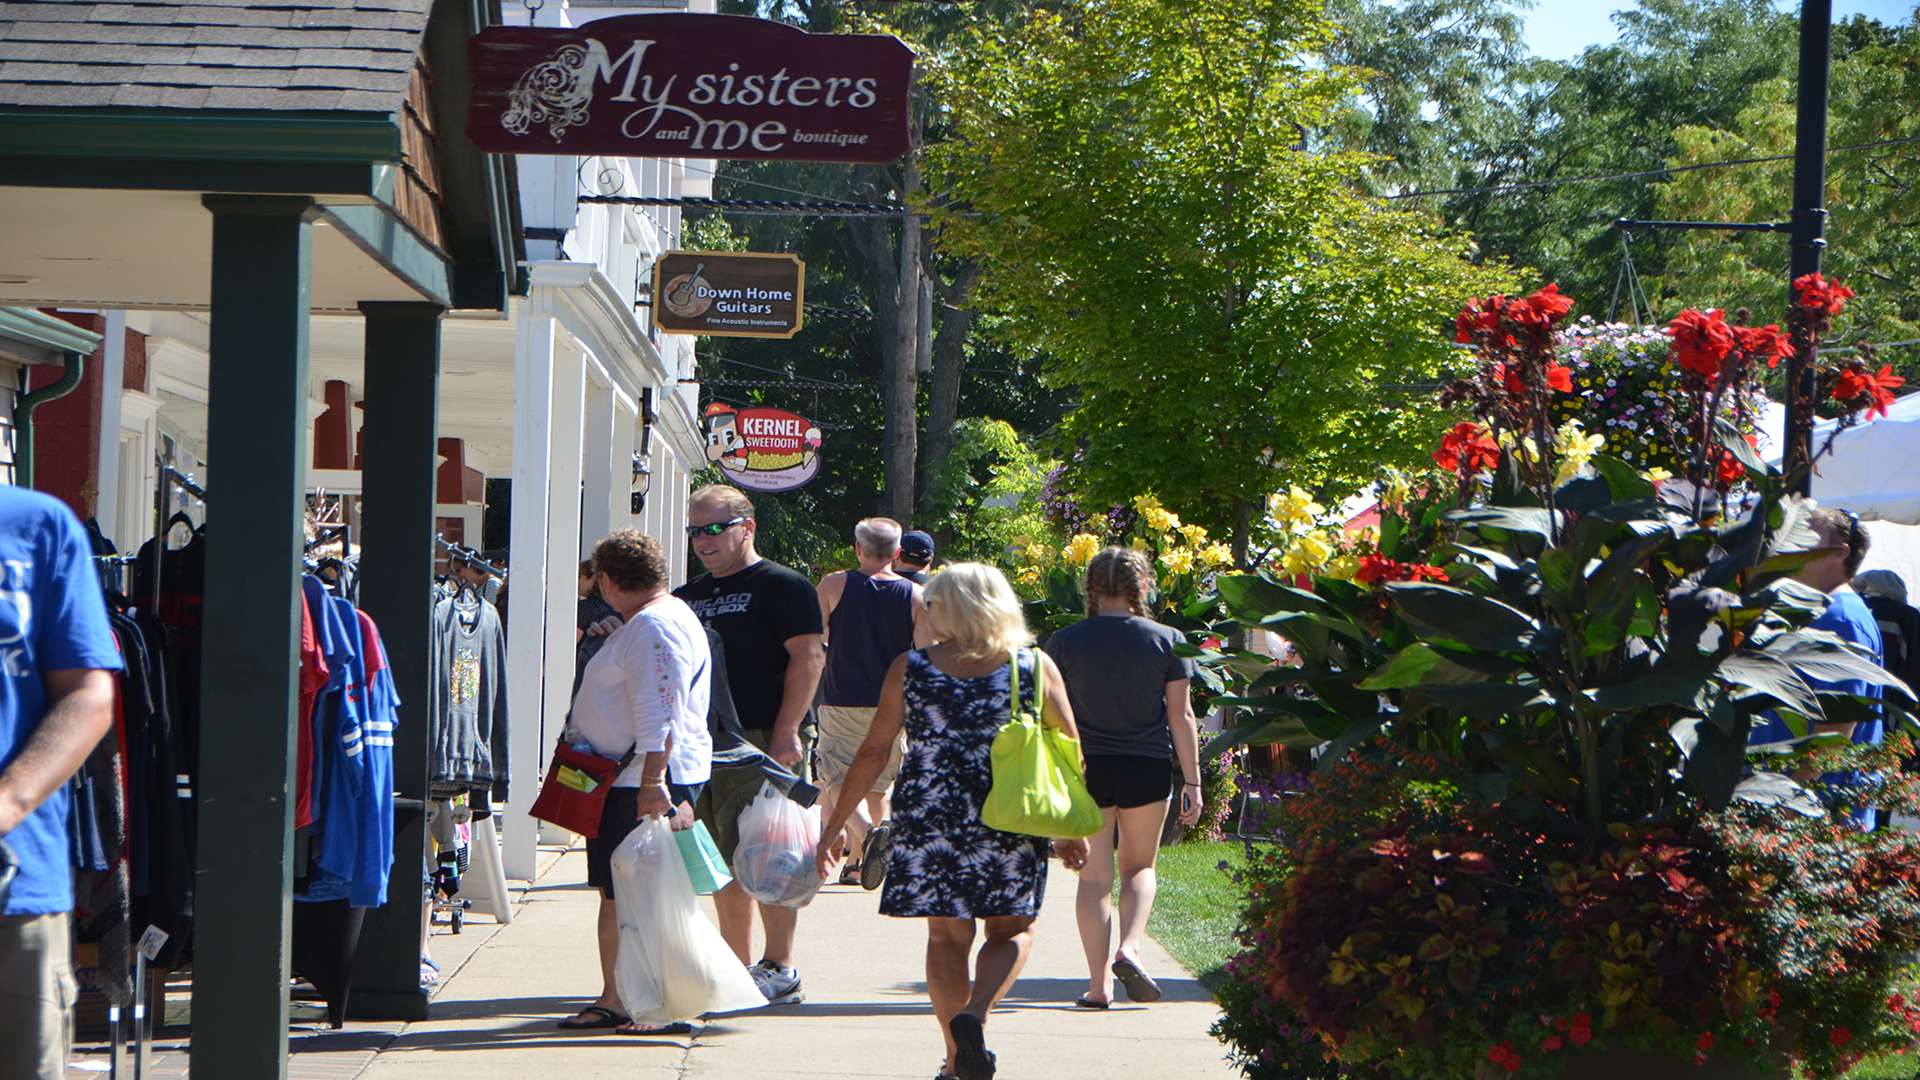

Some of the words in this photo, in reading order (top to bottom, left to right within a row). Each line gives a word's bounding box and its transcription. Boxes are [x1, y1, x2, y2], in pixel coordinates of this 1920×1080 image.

[583, 38, 677, 138] My
[688, 63, 877, 108] sisters
[655, 126, 690, 141] and
[690, 114, 786, 152] me
[793, 128, 868, 146] boutique
[697, 286, 742, 299] Down
[746, 287, 792, 300] Home
[716, 301, 772, 314] Guitars
[721, 317, 749, 325] Acoustic
[750, 318, 788, 327] Instruments
[743, 417, 803, 437] KERNEL
[745, 436, 799, 449] SWEETOOTH
[687, 592, 752, 610] HICAGO
